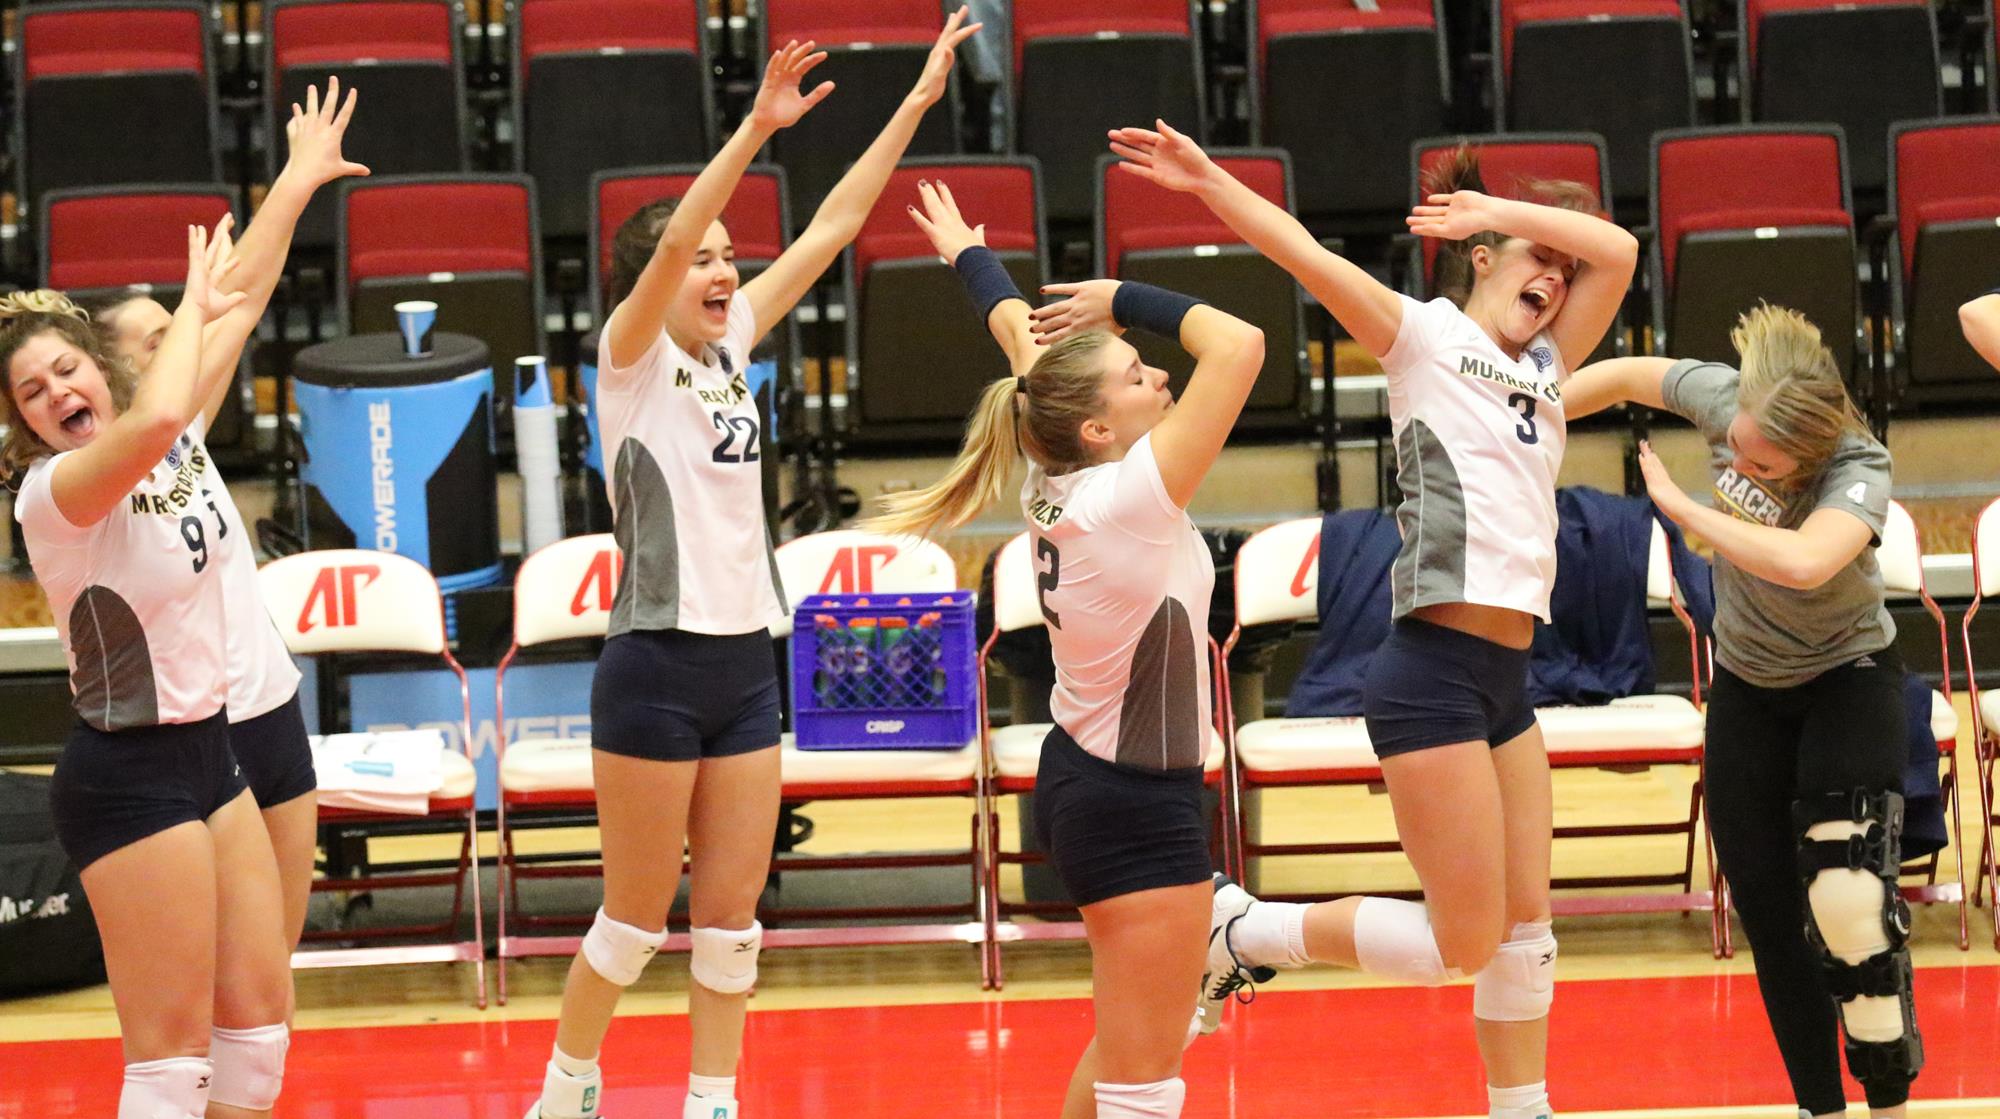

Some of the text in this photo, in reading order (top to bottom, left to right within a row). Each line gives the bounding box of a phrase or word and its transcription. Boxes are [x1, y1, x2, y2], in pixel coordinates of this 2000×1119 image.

[712, 411, 759, 463] 22
[1508, 392, 1539, 445] 3
[368, 399, 398, 553] OWERADE
[1846, 482, 1867, 504] 4
[180, 515, 208, 574] 9
[1037, 536, 1062, 631] 2
